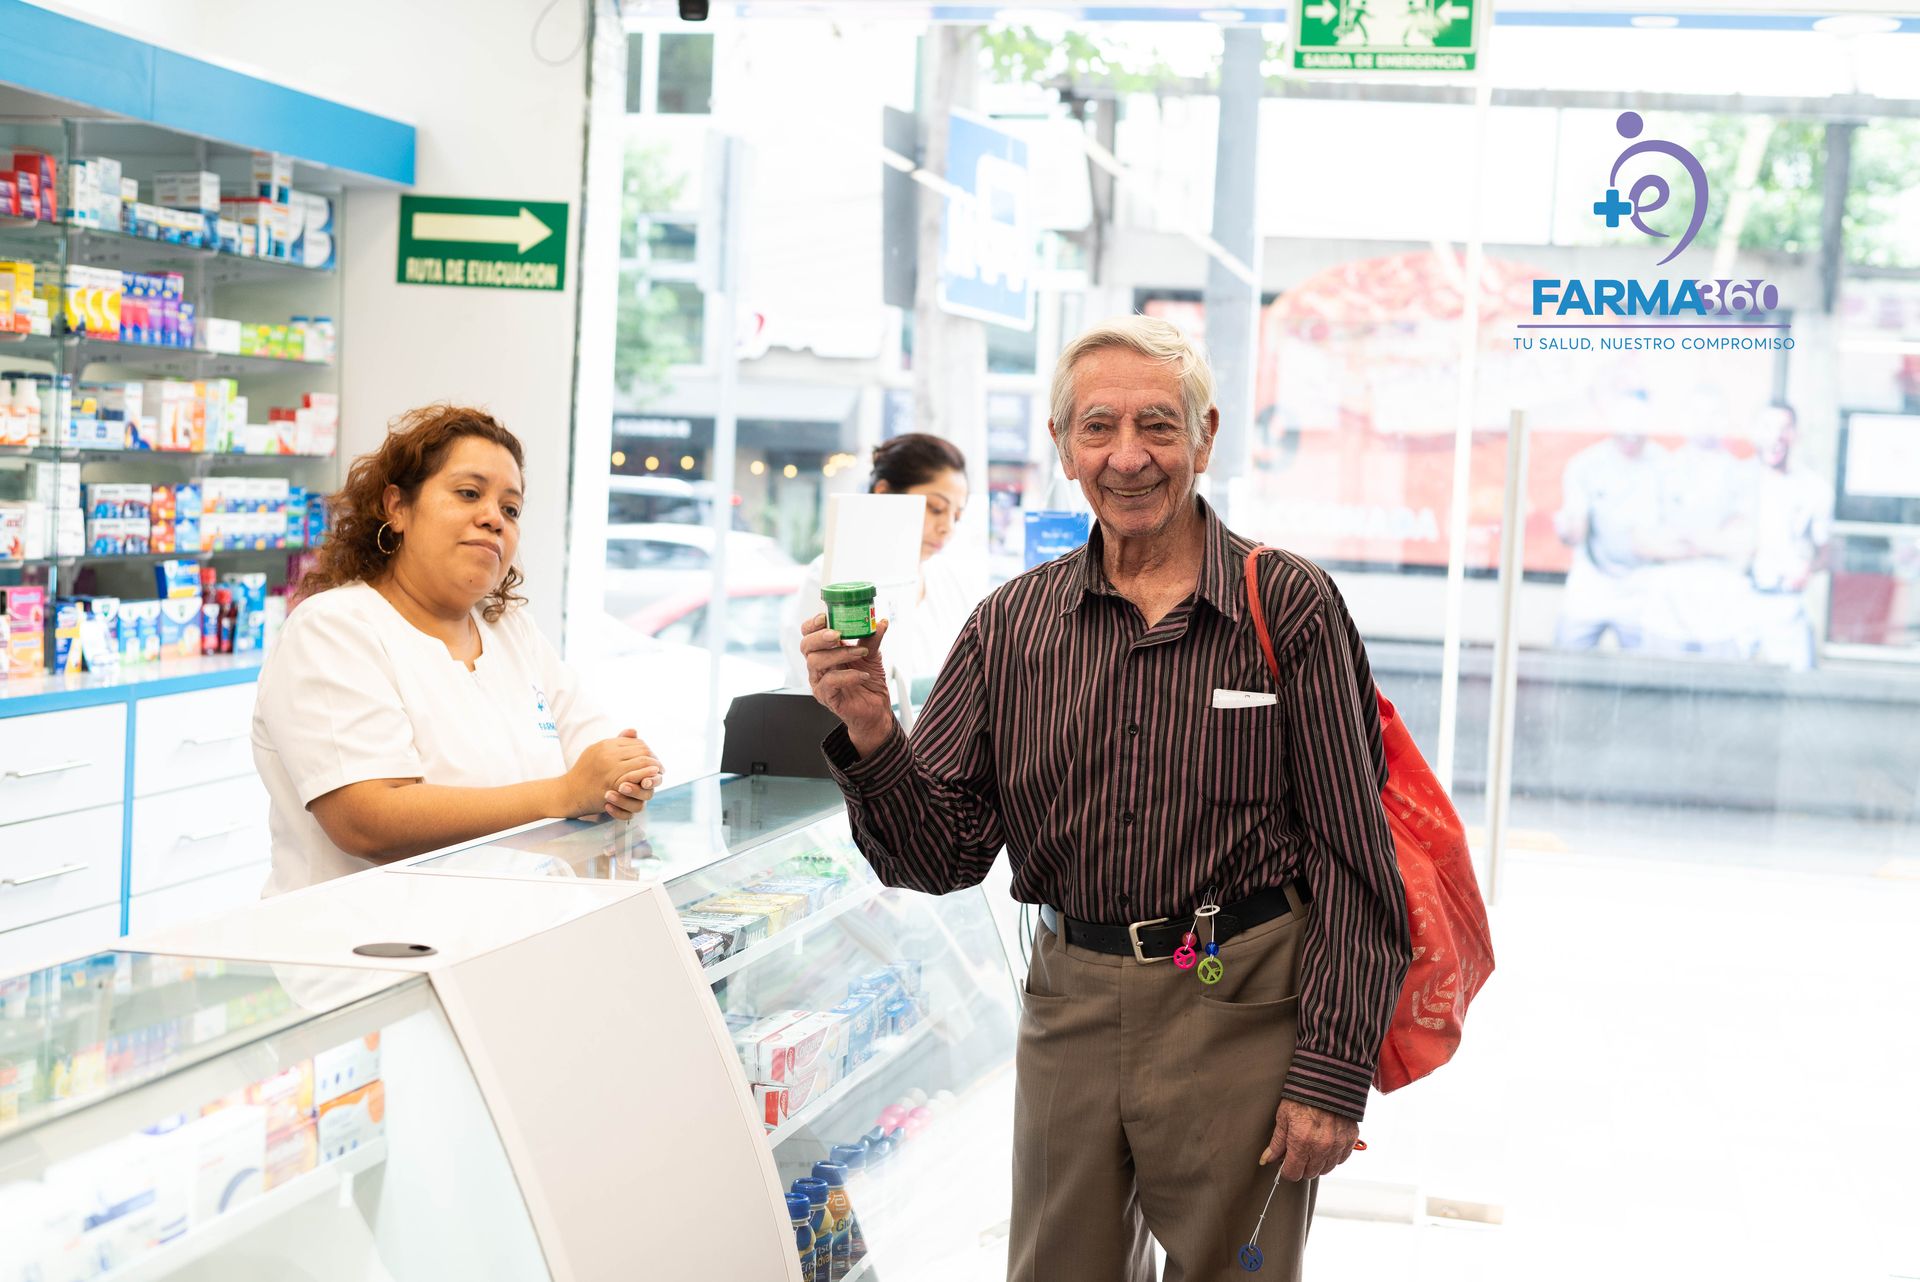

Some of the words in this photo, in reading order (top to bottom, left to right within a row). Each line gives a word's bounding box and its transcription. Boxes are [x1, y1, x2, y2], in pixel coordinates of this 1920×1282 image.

[1303, 53, 1352, 68] SALIDA
[1354, 53, 1374, 68] DE
[1375, 53, 1467, 69] EMERGENCIA
[406, 257, 443, 282] RUTA
[445, 258, 466, 284] DE
